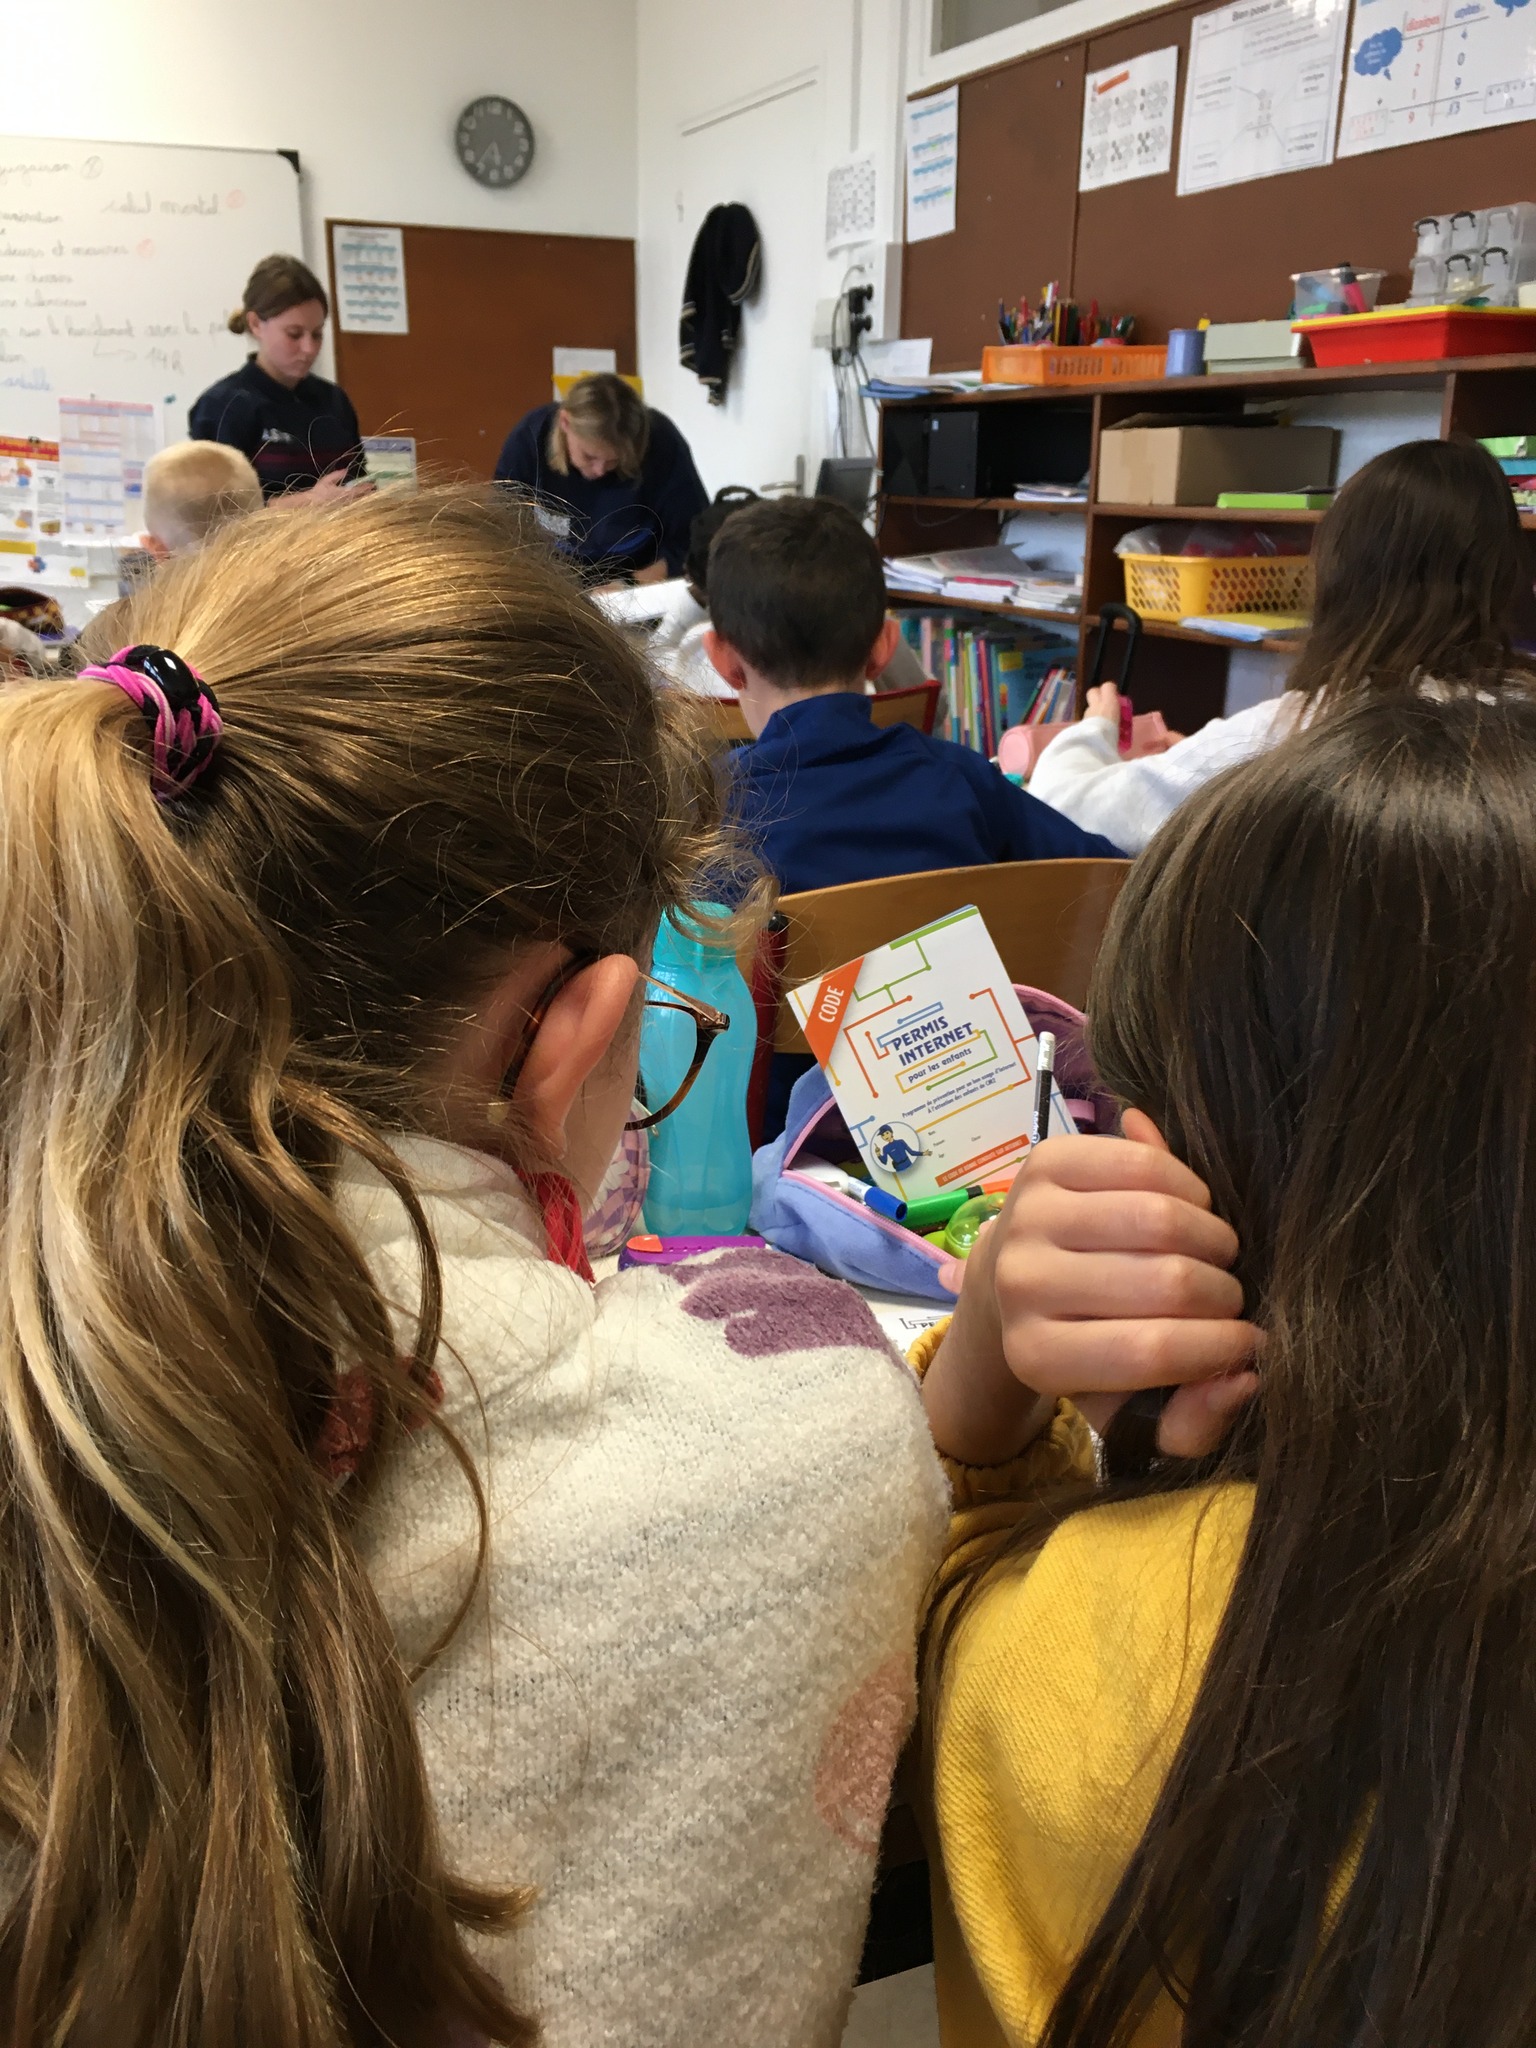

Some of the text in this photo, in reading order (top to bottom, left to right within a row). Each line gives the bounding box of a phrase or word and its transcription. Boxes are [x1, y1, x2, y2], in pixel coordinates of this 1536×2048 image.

[818, 985, 845, 1023] CODE
[892, 1016, 949, 1051] PERMIS
[898, 1022, 973, 1067] INTERNET
[908, 1048, 972, 1084] pour les enfants
[902, 1103, 927, 1119] Programme
